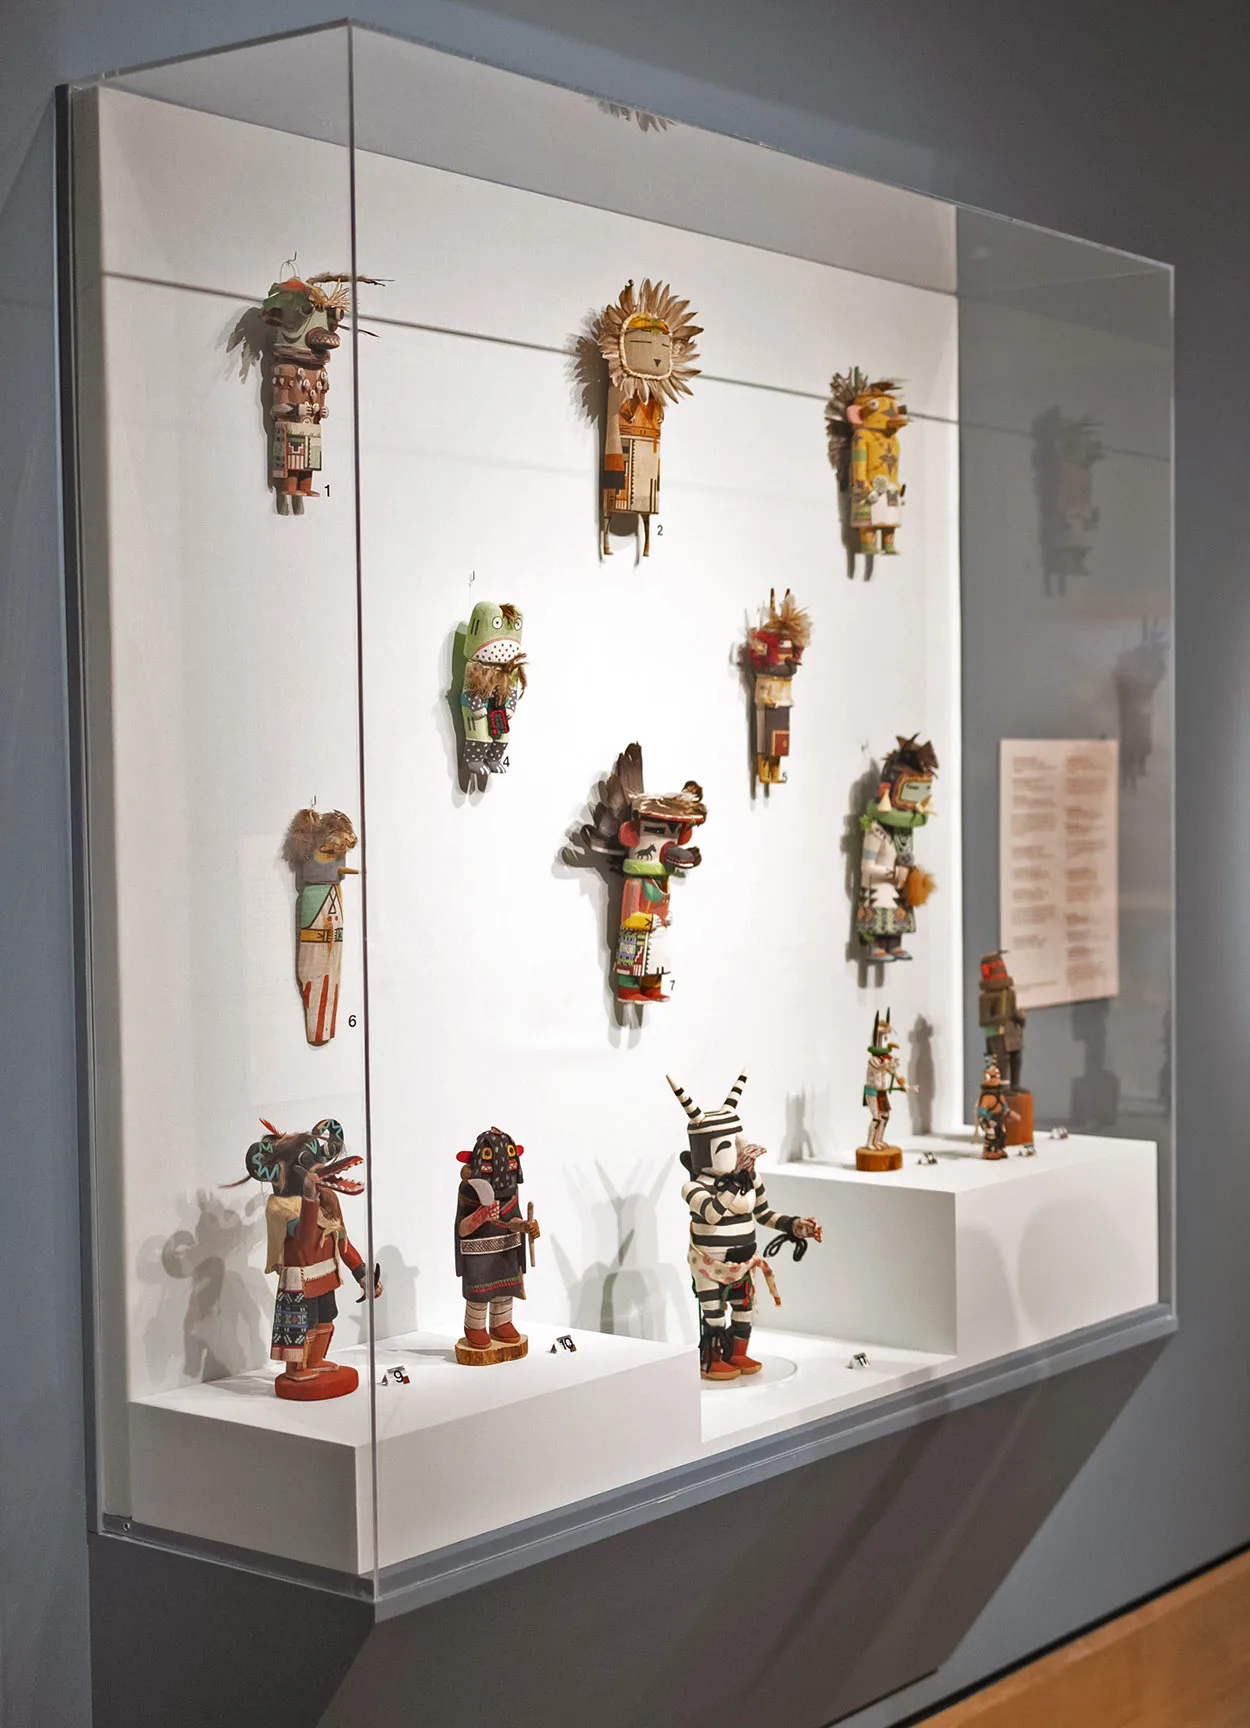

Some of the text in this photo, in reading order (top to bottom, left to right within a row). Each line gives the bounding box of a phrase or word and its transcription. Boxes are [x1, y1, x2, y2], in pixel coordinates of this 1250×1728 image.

[324, 484, 330, 497] 1
[657, 524, 664, 536] 2
[502, 756, 510, 768] 4
[782, 771, 788, 784] 5
[669, 979, 676, 991] 7
[348, 1014, 357, 1028] 6
[560, 1337, 573, 1350] 10
[393, 1370, 404, 1383] 9
